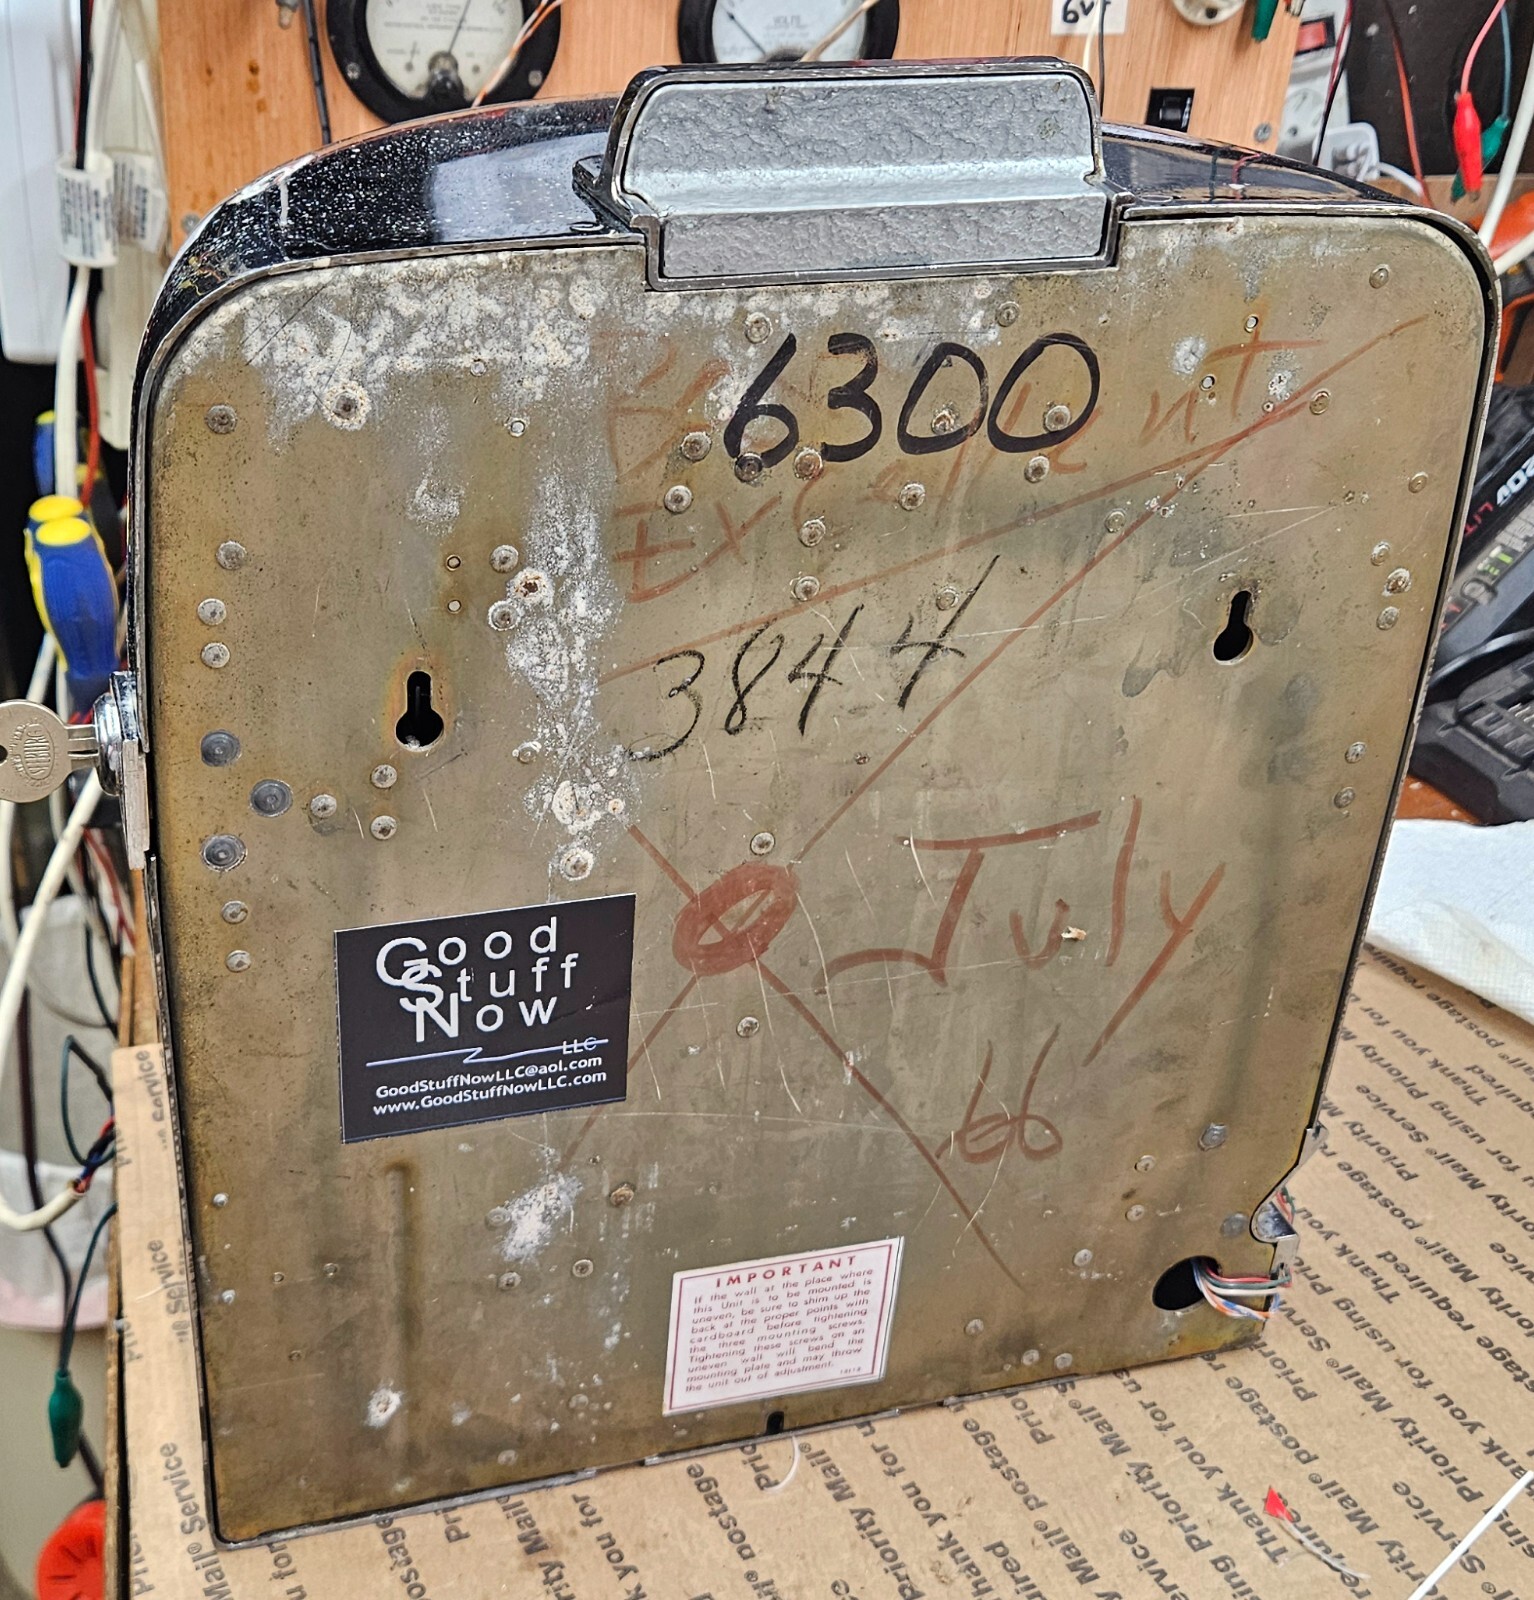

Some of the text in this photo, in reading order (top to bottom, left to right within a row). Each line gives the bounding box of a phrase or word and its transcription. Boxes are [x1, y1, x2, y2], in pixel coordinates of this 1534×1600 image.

[723, 331, 1100, 478] 6300
[628, 555, 999, 760] 3844
[376, 916, 557, 986] Good
[813, 797, 1226, 1067] July
[400, 953, 579, 1013] Stuff
[416, 992, 557, 1043] Now
[1426, 993, 1505, 1048] postage
[562, 1037, 597, 1055] LLC
[1360, 1006, 1488, 1106] Thank you for
[373, 1071, 607, 1116] www.GoodStuffNowLLC.com
[375, 1056, 602, 1099] GoodStuffNowLLC@aol.com
[1356, 1044, 1521, 1174] for using Priority
[1356, 1084, 1429, 1143] Service
[1343, 1120, 1419, 1181] Priority
[1337, 1160, 1423, 1230] postage
[716, 1256, 856, 1288] IMPORTANT
[1298, 1206, 1400, 1304] Thank you
[693, 1306, 713, 1314] this
[721, 1300, 743, 1310] Unit
[768, 1294, 779, 1302] to
[786, 1290, 800, 1298] be
[808, 1281, 855, 1295] mounted
[863, 1278, 872, 1286] is
[694, 1295, 703, 1304] If
[710, 1292, 727, 1302] the
[735, 1287, 757, 1297] wall
[782, 1280, 799, 1289] the
[804, 1276, 833, 1288] place
[840, 1269, 873, 1279] where
[741, 1308, 754, 1316] be
[760, 1303, 783, 1313] sure
[803, 1296, 829, 1306] shim
[834, 1293, 848, 1301] up
[853, 1288, 871, 1297] the
[1375, 1250, 1476, 1331] required
[689, 1308, 868, 1344] cardboard before tightening
[689, 1319, 865, 1354] the three mounting screws.
[691, 1298, 869, 1334] back at the proper points with
[1333, 1297, 1396, 1353] using
[686, 1347, 862, 1383] mounting plate and may throw
[687, 1337, 864, 1373] uneven wall will bend the
[689, 1348, 746, 1363] Tightening
[753, 1342, 782, 1352] these
[789, 1335, 824, 1346] screws
[831, 1331, 845, 1339] on
[1396, 1356, 1434, 1390] for
[685, 1384, 703, 1392] the
[708, 1379, 729, 1388] unit
[734, 1375, 752, 1384] out
[774, 1360, 834, 1377] adjustment.
[1225, 1376, 1320, 1465] postage
[1433, 1392, 1487, 1434] you
[871, 1442, 906, 1478] for
[962, 1417, 1048, 1511] postage
[1139, 1400, 1289, 1565] Thank you for
[1391, 1415, 1485, 1502] Priority
[160, 1442, 206, 1535] Service
[572, 1494, 604, 1528] for
[686, 1463, 757, 1561] postage
[901, 1481, 948, 1527] you
[1126, 1461, 1213, 1552] Priority
[596, 1531, 640, 1581] you
[850, 1507, 926, 1600] Priority
